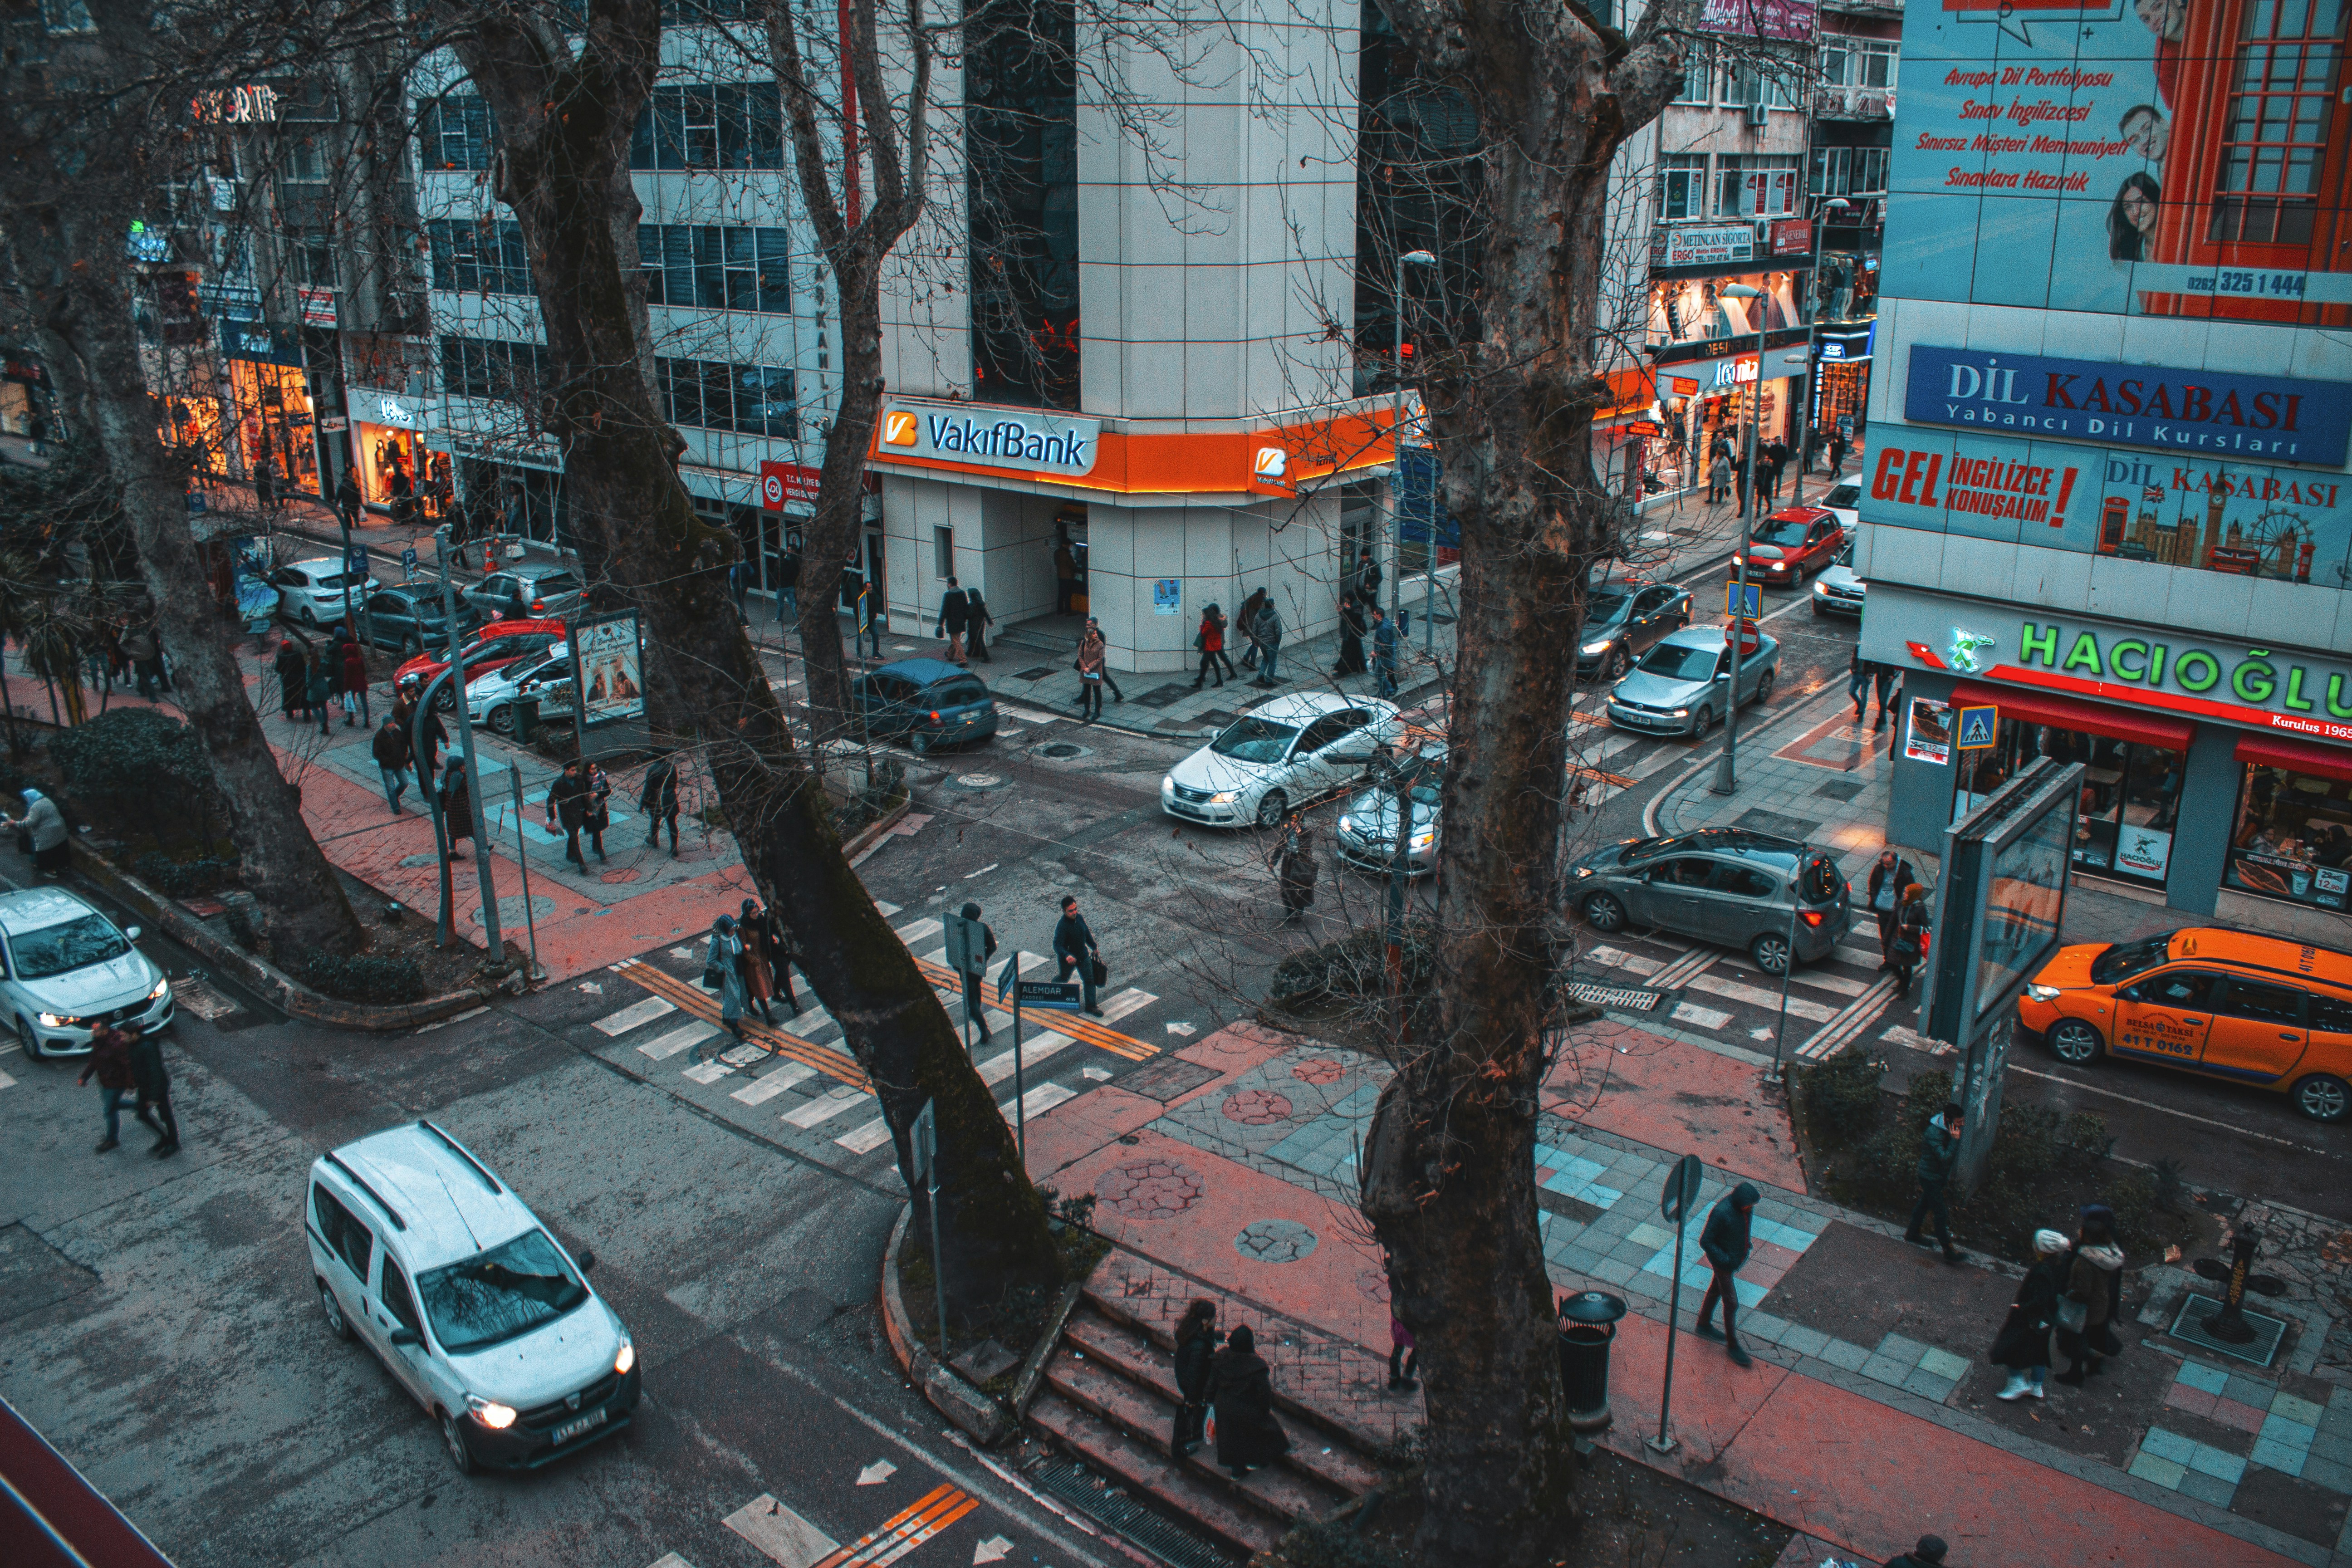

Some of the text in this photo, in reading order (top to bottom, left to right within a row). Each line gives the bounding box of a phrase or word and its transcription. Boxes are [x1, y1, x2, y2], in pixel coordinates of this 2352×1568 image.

[1944, 67, 2114, 92] Avrupa Dil Portfolyosu
[1958, 95, 2093, 127] Sınav İngilizcesi
[1915, 132, 2132, 160] Sınırsız Müşteri Memnuniyeti
[1945, 167, 2090, 192] Sınavlara Hazırlık
[1682, 229, 1751, 248] METİNCAN SİGORTA
[1672, 250, 1693, 261] ERGO
[2187, 272, 2306, 296] 0262 325 1 444
[1946, 358, 2304, 432] DİL KASABASI
[928, 415, 1088, 466] VakıfBank
[1946, 404, 2297, 455] Yabancı Dil Kursları
[796, 476, 815, 487] MLİYE
[1871, 448, 1943, 508] GEL
[1947, 452, 2054, 495] İNGİLİZCE
[2105, 457, 2342, 509] DİL KASABASI
[1945, 488, 2049, 523] KONUŞALIM
[406, 551, 414, 564] P
[2019, 622, 2352, 719] HACIOĞLU
[2272, 715, 2352, 739] Kuruluş 1965
[2119, 852, 2162, 866] HACIOĞLU
[1022, 986, 1062, 995] ALEMDAR
[2127, 1018, 2154, 1029] BELSA
[2167, 1026, 2194, 1037] TAKSİ
[2123, 1034, 2139, 1045] 41
[2144, 1037, 2153, 1047] T
[2157, 1039, 2193, 1055] 0162
